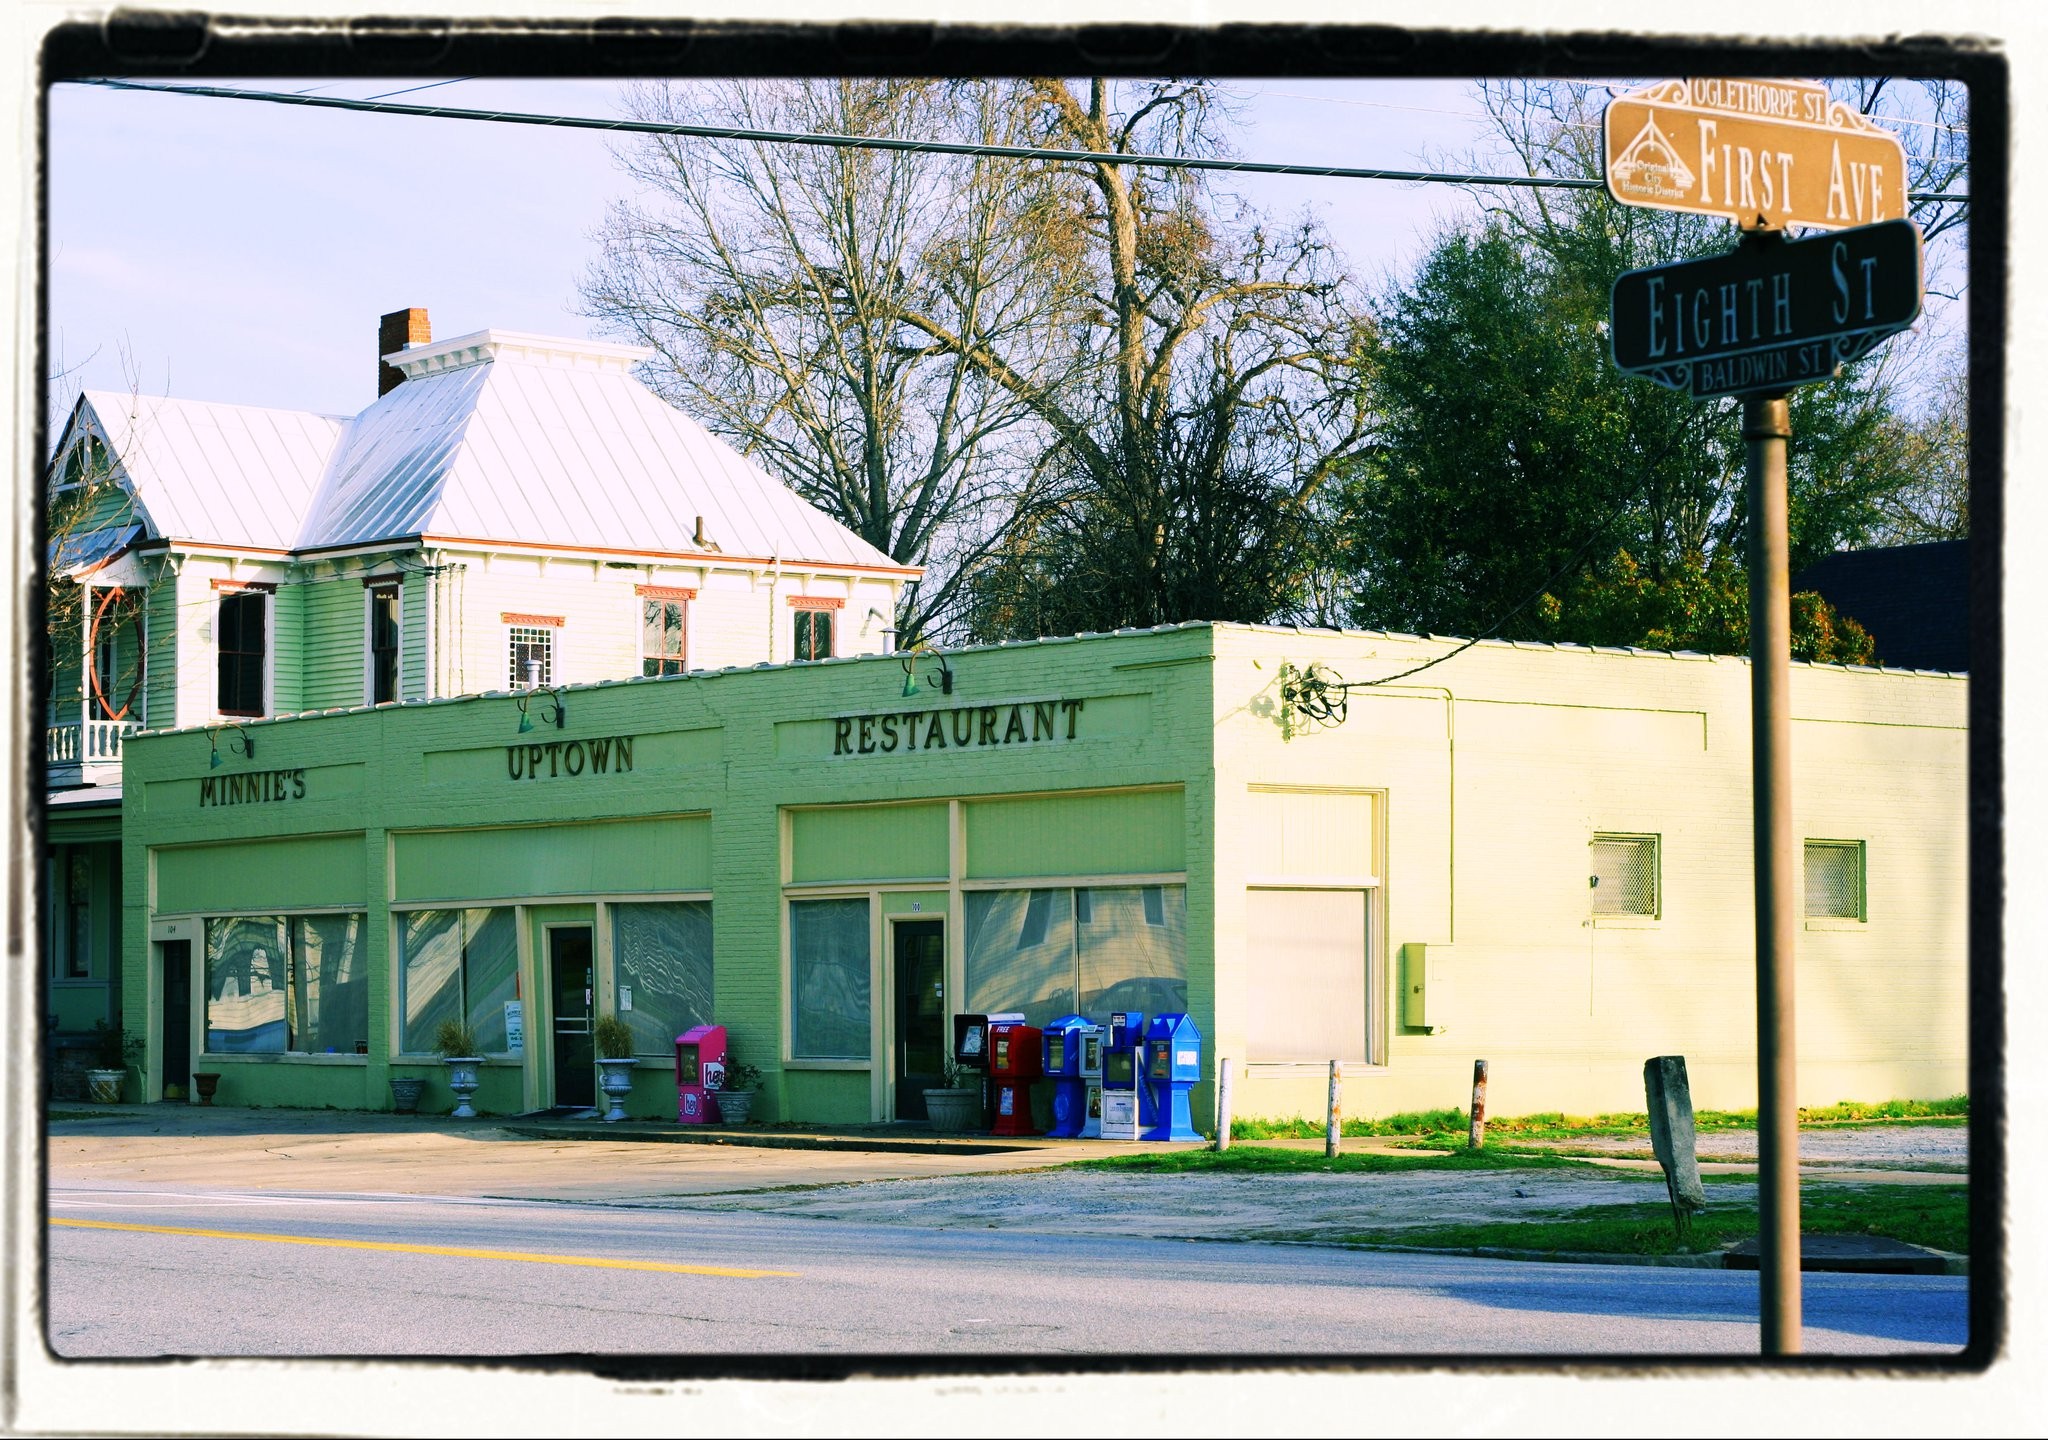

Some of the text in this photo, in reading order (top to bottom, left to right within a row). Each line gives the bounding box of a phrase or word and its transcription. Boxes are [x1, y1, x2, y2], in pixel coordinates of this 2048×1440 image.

[1694, 78, 1798, 119] OGLETHORPE
[1698, 118, 1886, 224] FIRST AVE
[1647, 241, 1878, 358] EIGHTH ST
[1701, 350, 1788, 391] BALDWIN
[833, 699, 1084, 756] RESTAURANT
[507, 736, 634, 781] UPTOWN
[199, 769, 307, 808] MINNIE'S
